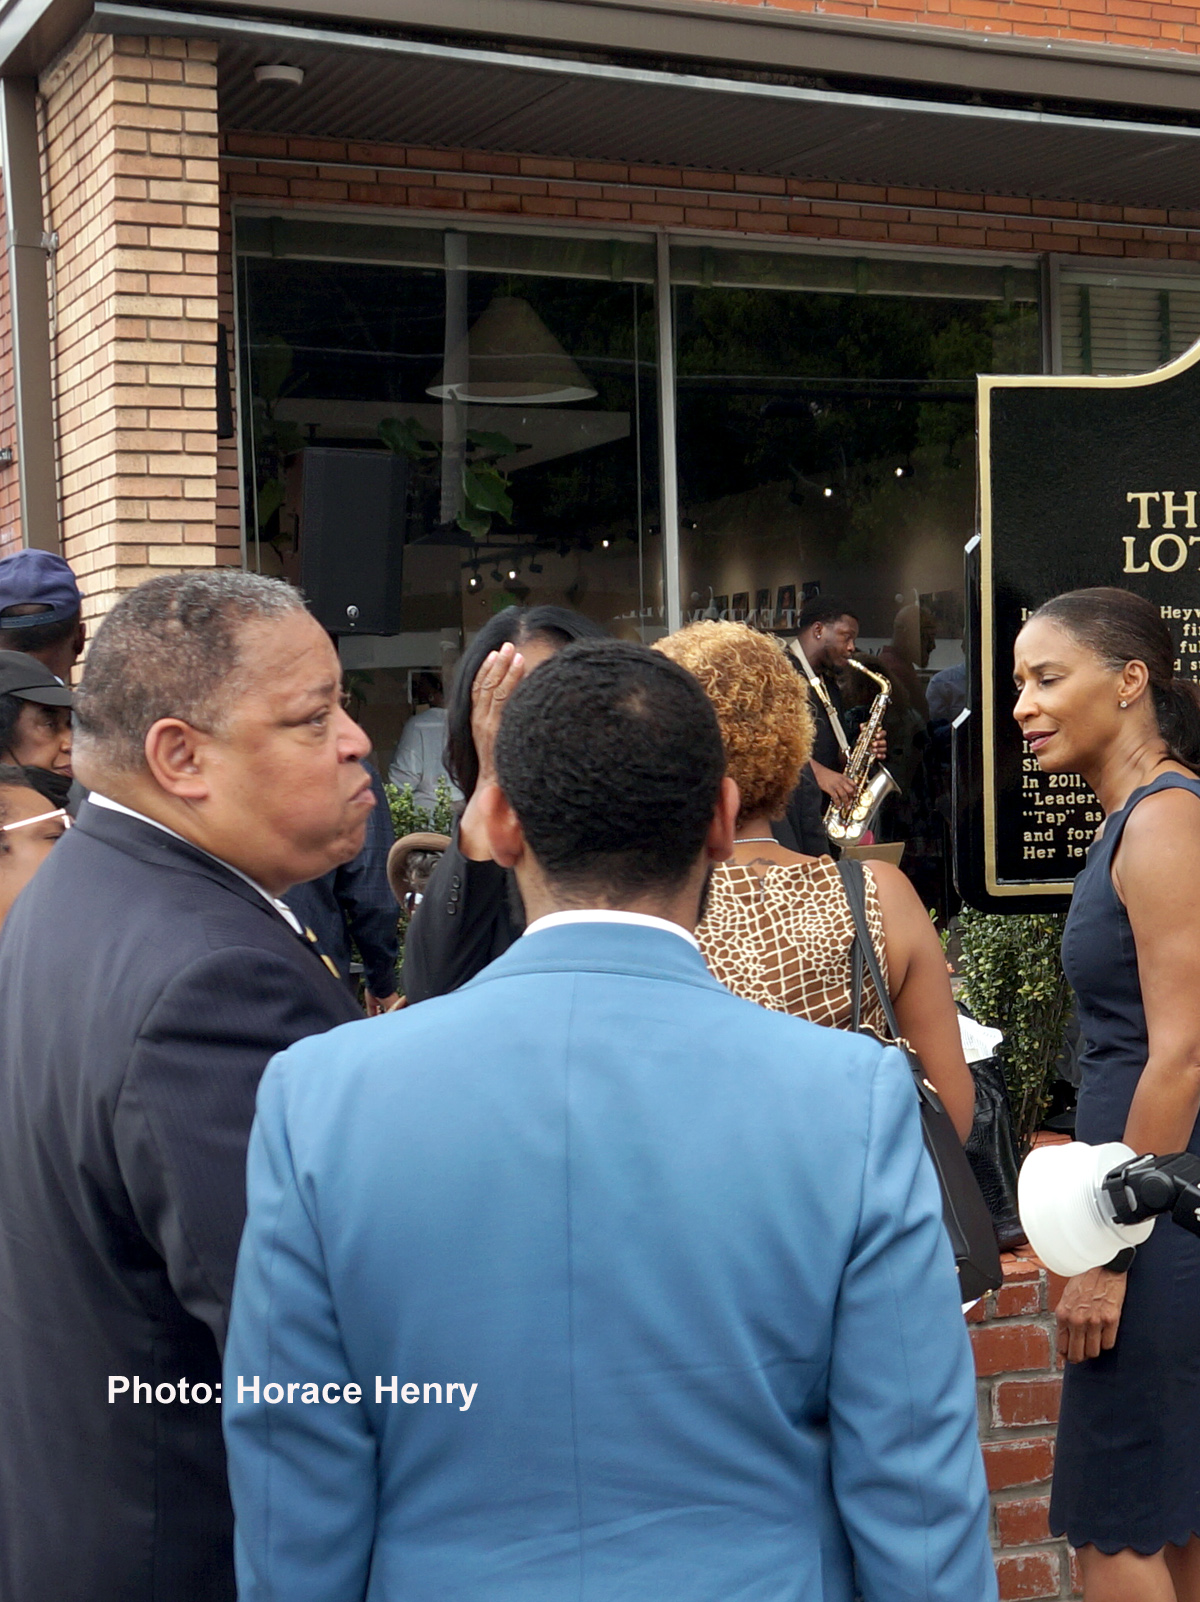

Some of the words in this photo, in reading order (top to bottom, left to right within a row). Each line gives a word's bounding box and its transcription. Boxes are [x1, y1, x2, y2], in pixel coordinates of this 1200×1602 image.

[1022, 775, 1040, 789] In
[1048, 774, 1087, 788] 2011,
[1085, 811, 1102, 822] as
[1023, 829, 1054, 842] and
[1067, 827, 1099, 841] for
[1023, 846, 1056, 859] Her
